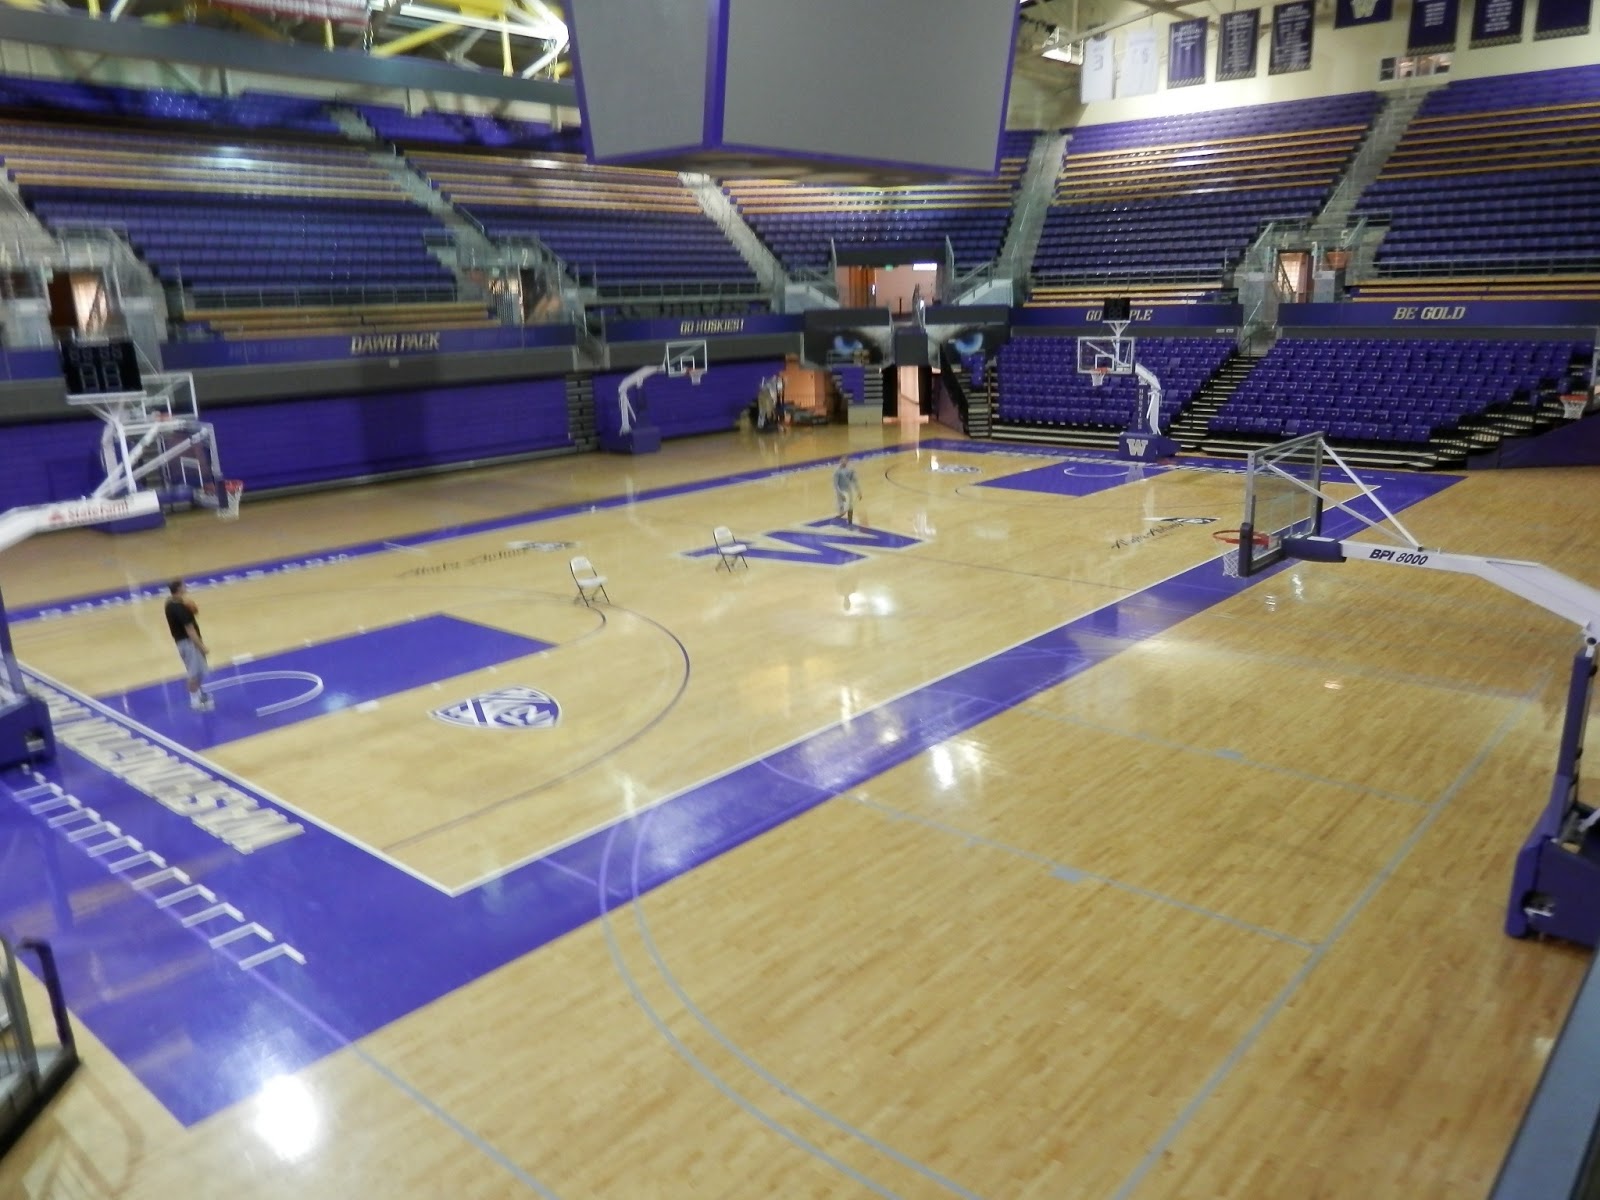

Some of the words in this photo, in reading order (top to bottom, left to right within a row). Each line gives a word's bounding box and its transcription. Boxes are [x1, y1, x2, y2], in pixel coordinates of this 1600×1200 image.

[1086, 310, 1102, 322] GO
[1393, 306, 1419, 320] BE
[1420, 306, 1466, 320] GOLD
[351, 335, 398, 355] DAWG
[400, 331, 440, 351] PACK
[1126, 438, 1149, 456] W
[1369, 549, 1395, 561] BPI
[1396, 552, 1429, 566] 8000
